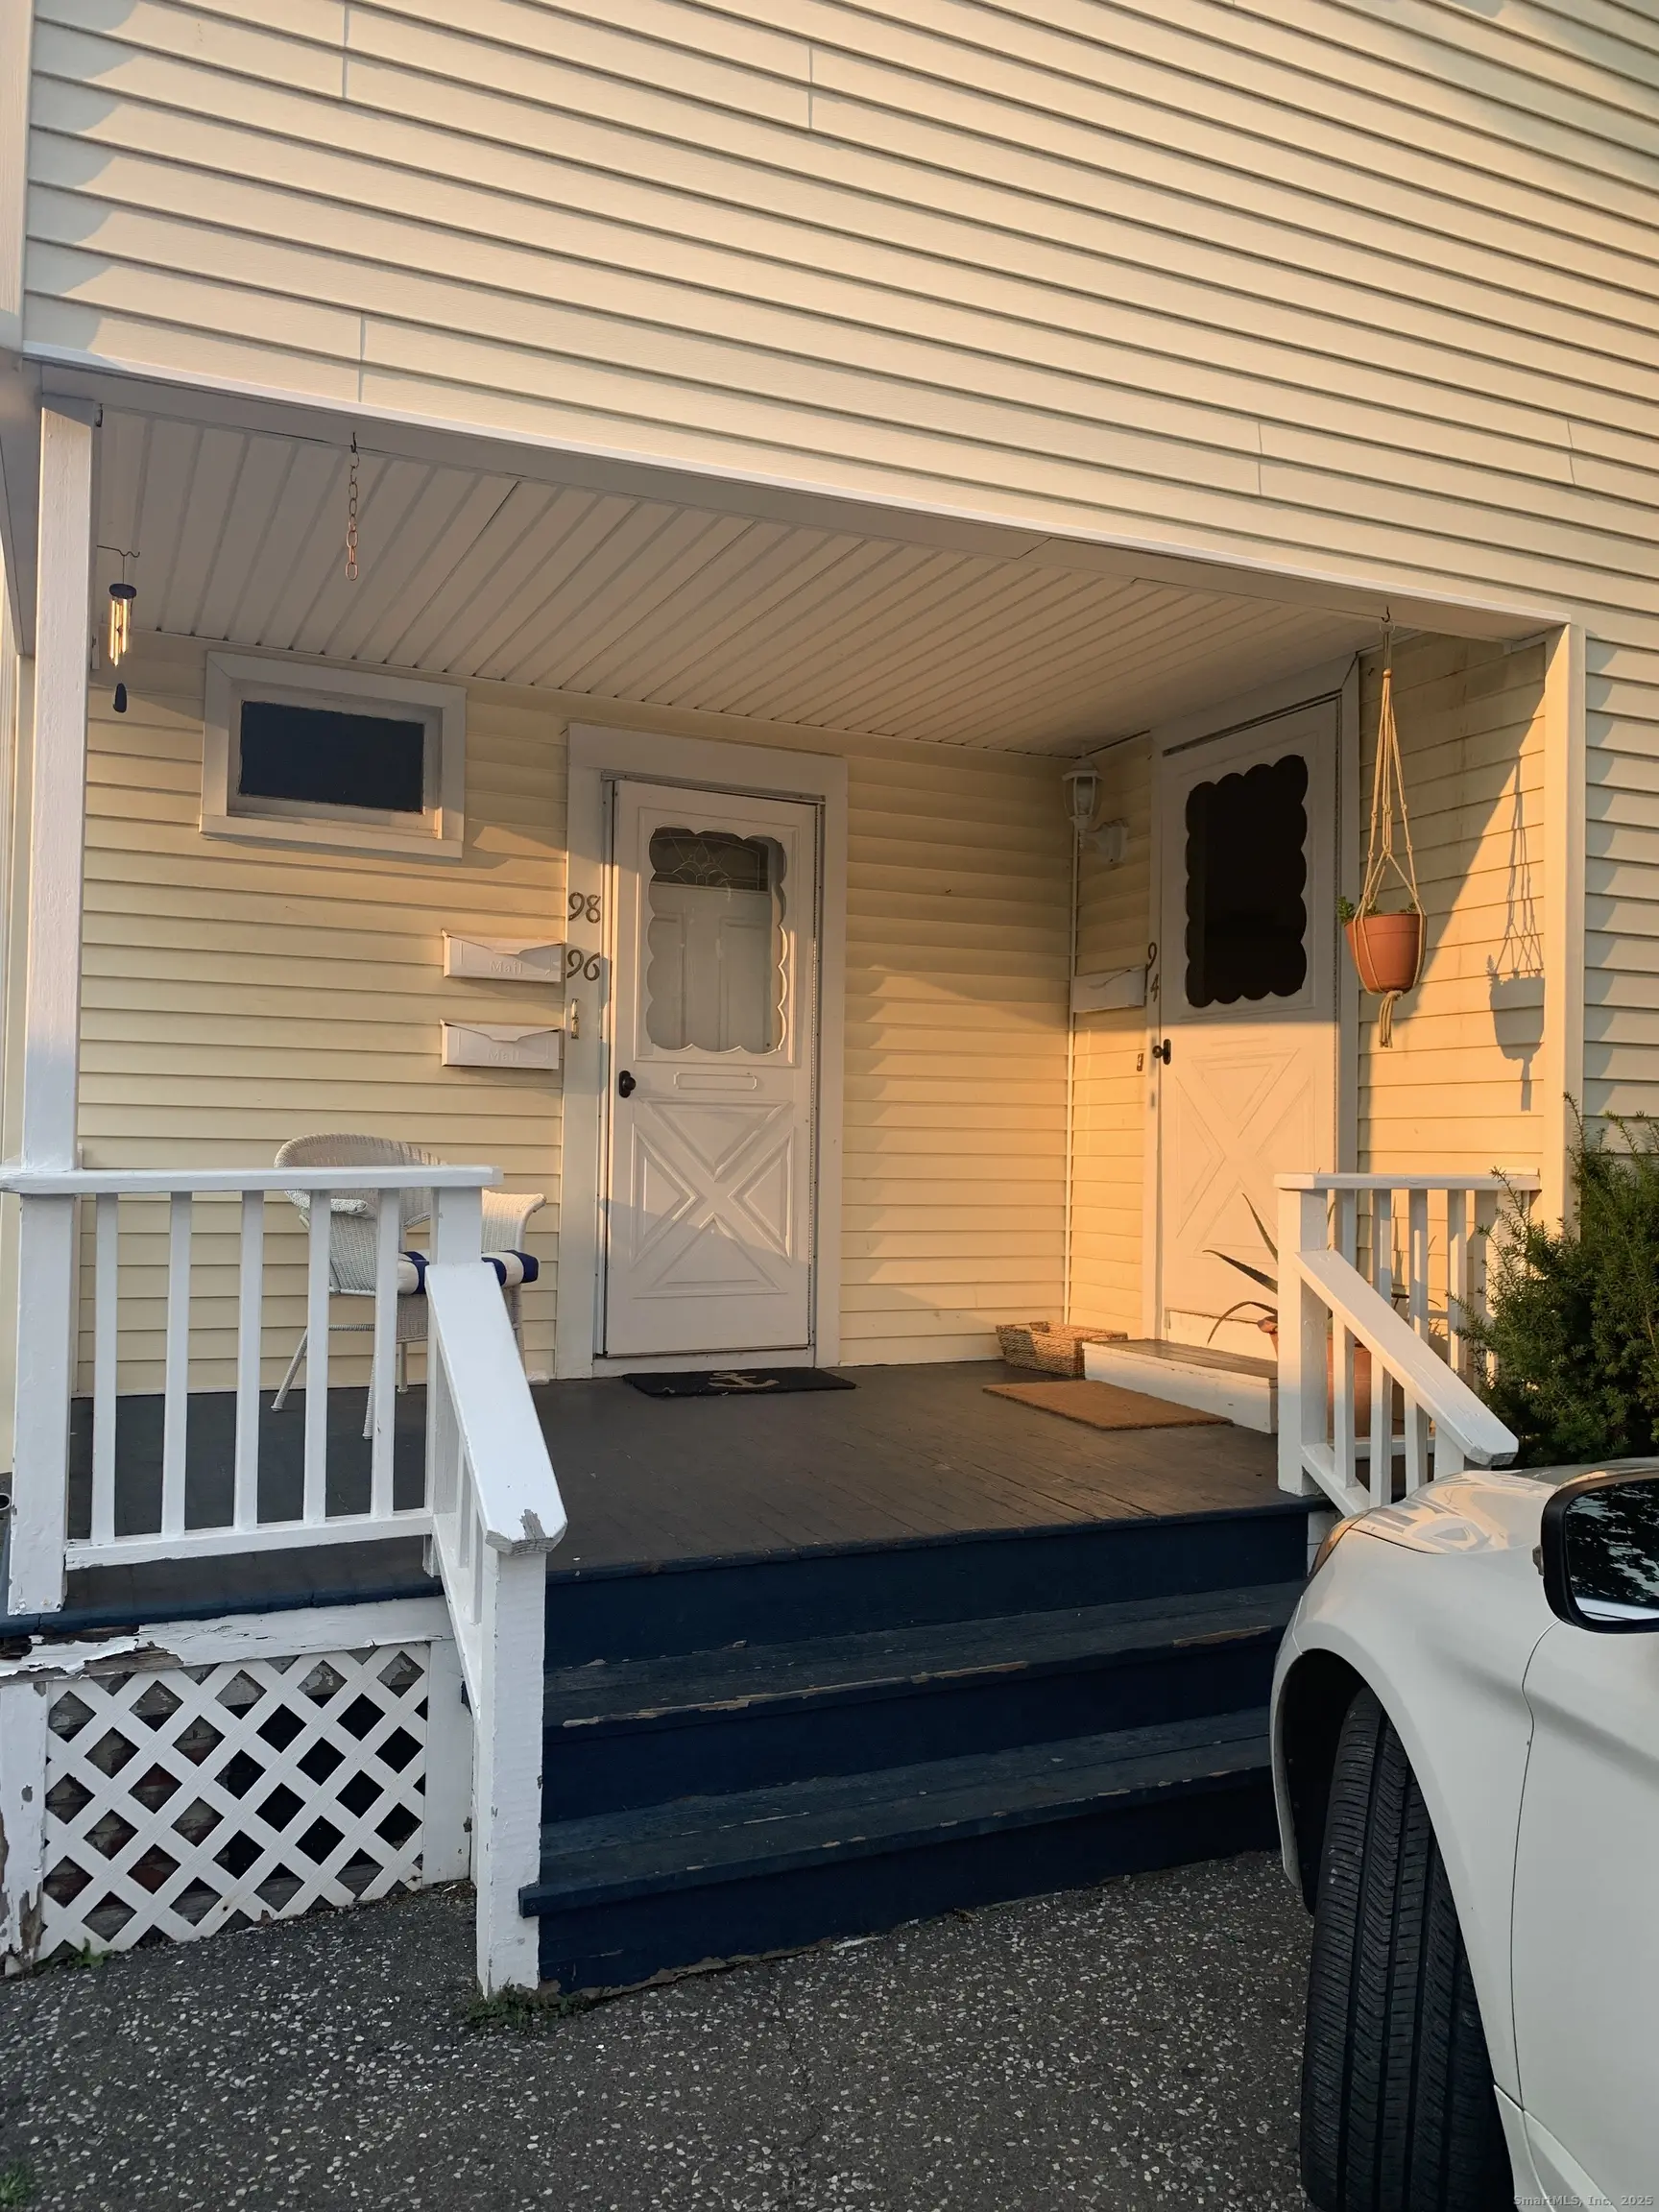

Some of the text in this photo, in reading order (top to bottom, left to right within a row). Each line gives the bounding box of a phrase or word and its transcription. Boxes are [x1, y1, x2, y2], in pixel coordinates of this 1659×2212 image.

[568, 892, 601, 923] 98
[490, 960, 522, 974] Mail
[567, 949, 600, 980] 96
[488, 1049, 519, 1063] Mail
